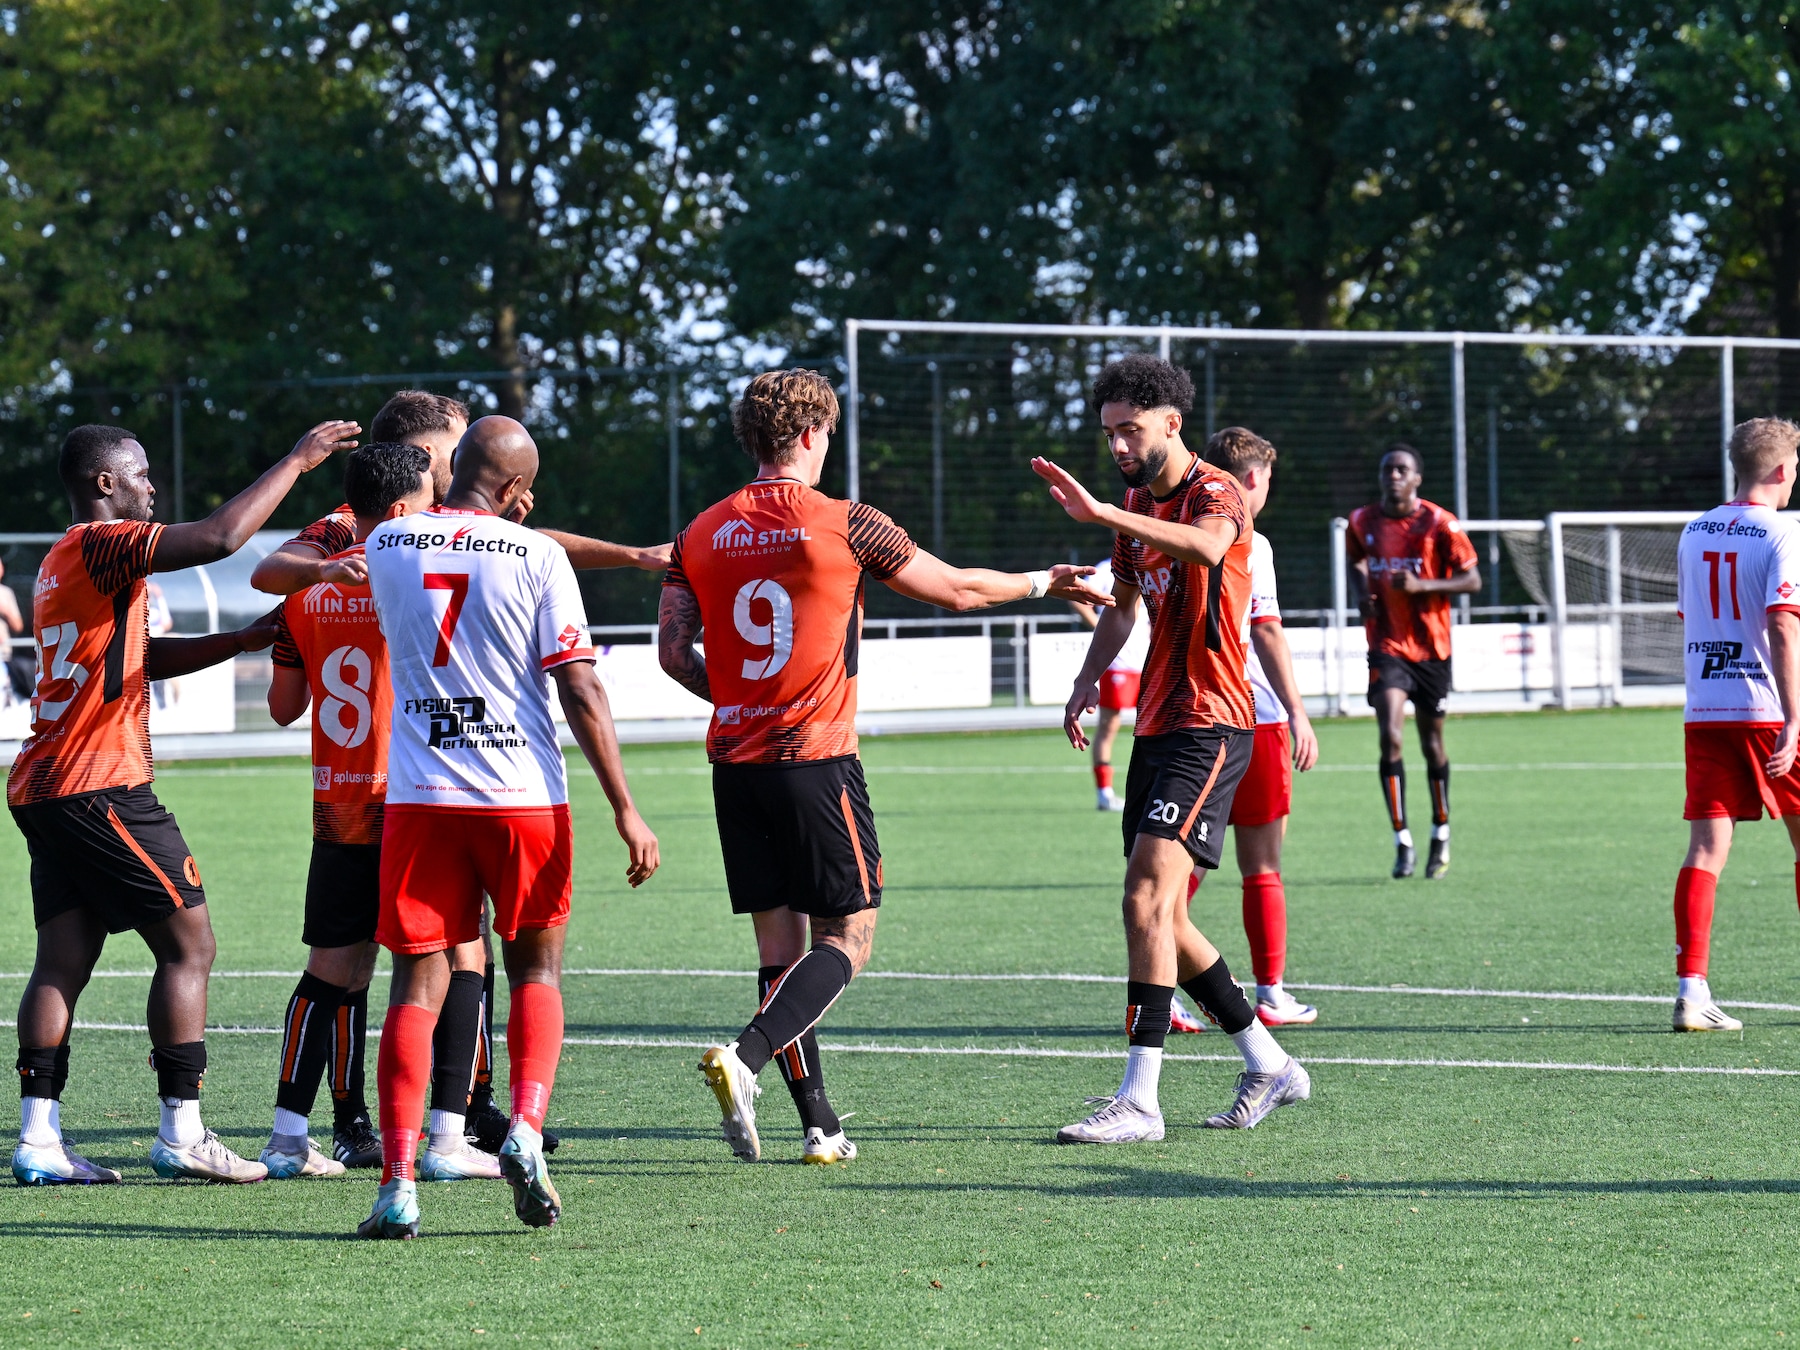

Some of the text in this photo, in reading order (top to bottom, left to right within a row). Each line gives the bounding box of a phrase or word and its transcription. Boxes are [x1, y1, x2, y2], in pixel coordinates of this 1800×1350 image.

[734, 527, 812, 547] IN STIJL
[1687, 521, 1767, 538] Strago Electro
[377, 533, 528, 557] Strago Electro
[726, 546, 792, 557] TOTAALBOUW
[1703, 551, 1741, 620] 11
[324, 597, 375, 613] IN STI
[316, 616, 379, 624] TOTAALBOUW
[423, 573, 469, 667] 7
[733, 579, 793, 680] 9
[1688, 641, 1722, 653] FYSIO
[319, 645, 371, 748] 8
[404, 698, 451, 714] FYSIO
[333, 771, 388, 786] aplusrecla
[1148, 799, 1179, 824] 20
